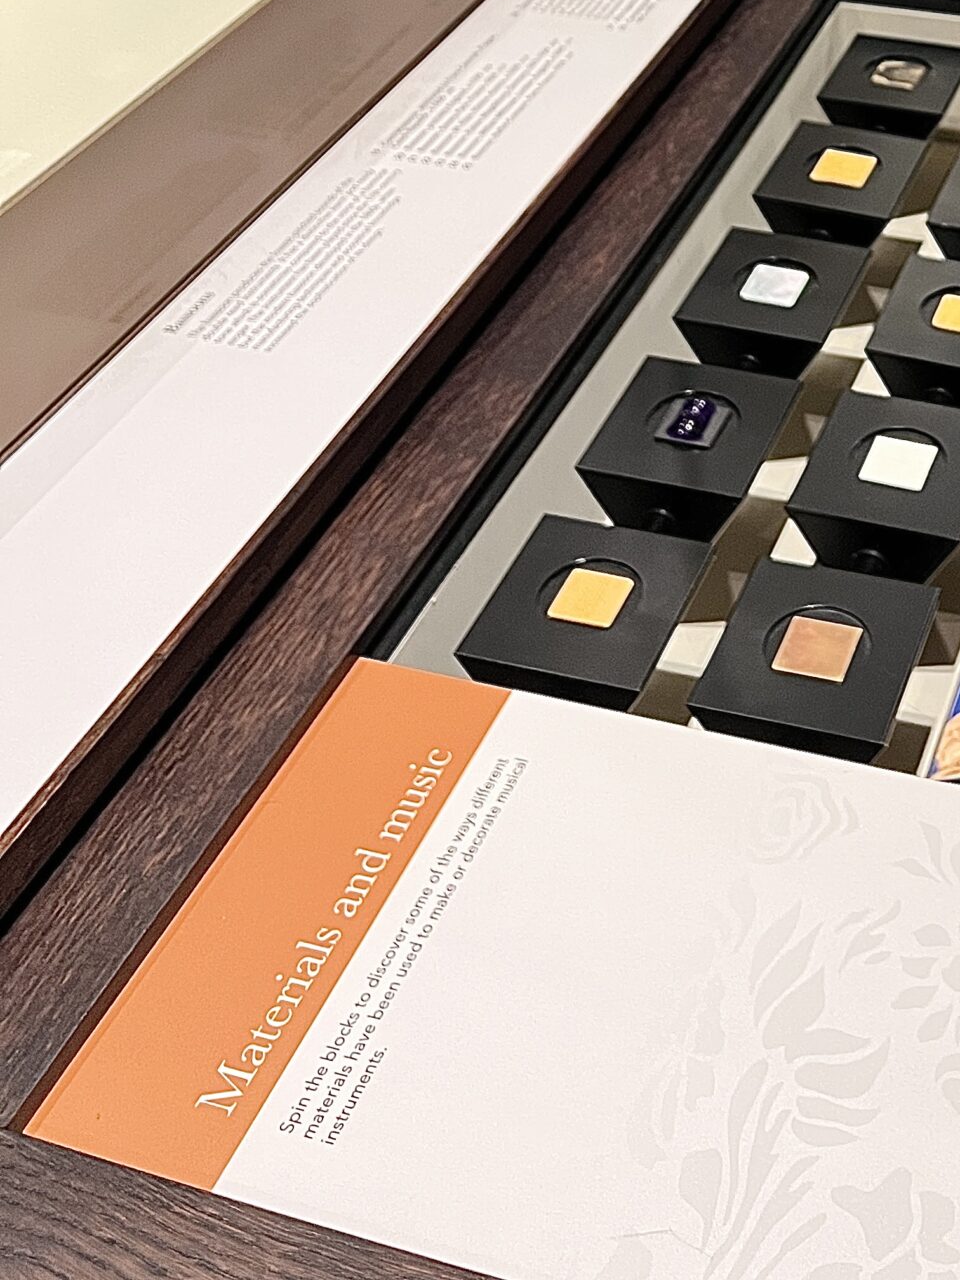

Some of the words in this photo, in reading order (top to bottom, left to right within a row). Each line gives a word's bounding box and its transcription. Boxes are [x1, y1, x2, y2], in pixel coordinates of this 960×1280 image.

[471, 757, 510, 810] different
[452, 811, 478, 843] ways
[436, 844, 458, 867] the
[429, 867, 444, 884] of
[405, 886, 433, 925] some
[194, 927, 342, 1118] Materials
[333, 847, 392, 918] and
[379, 748, 453, 843] music
[303, 1064, 353, 1140] materials
[343, 1024, 376, 1061] have
[367, 981, 401, 1021] been
[396, 941, 423, 978] used
[417, 923, 434, 939] to
[430, 883, 457, 921] make
[452, 864, 467, 881] or
[460, 806, 502, 864] decorate
[497, 757, 529, 803] musical
[366, 927, 410, 988] discover
[354, 992, 371, 1008] to
[319, 1011, 360, 1062] blocks
[305, 1065, 328, 1092] the
[320, 1046, 389, 1146] instruments.
[279, 1096, 311, 1134] Spin
